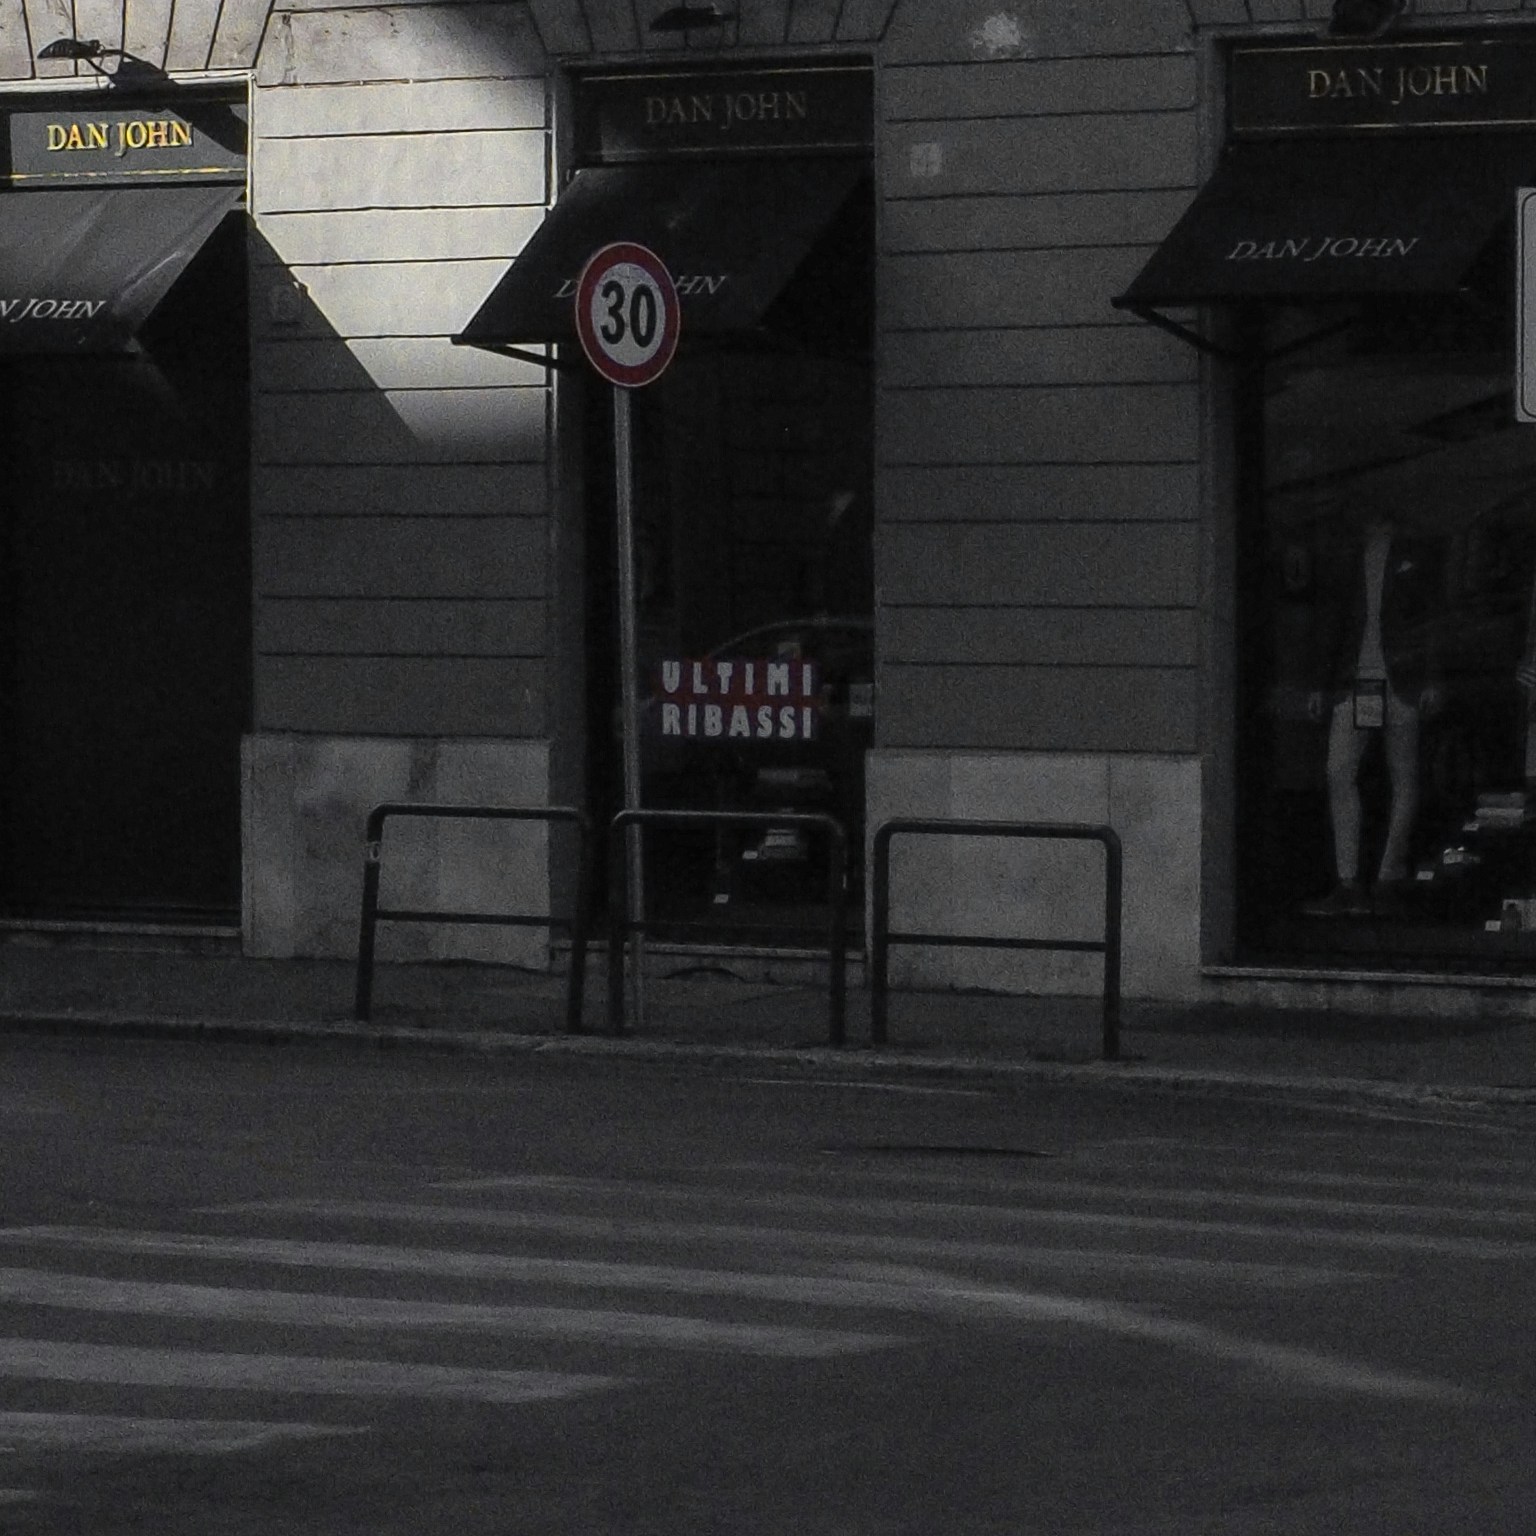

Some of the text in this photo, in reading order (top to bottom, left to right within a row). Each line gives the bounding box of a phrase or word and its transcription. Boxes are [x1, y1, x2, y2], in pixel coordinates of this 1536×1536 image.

[1307, 64, 1489, 106] DAN JOHN
[645, 90, 808, 131] DAN JOHN
[47, 121, 194, 158] DAN JOHN
[1225, 236, 1420, 263] DAN JOHN
[673, 275, 729, 296] HN
[9, 298, 107, 323] JOHN
[601, 280, 657, 348] 30
[662, 660, 812, 696] ULTIMI
[662, 703, 812, 739] RIBASSI
